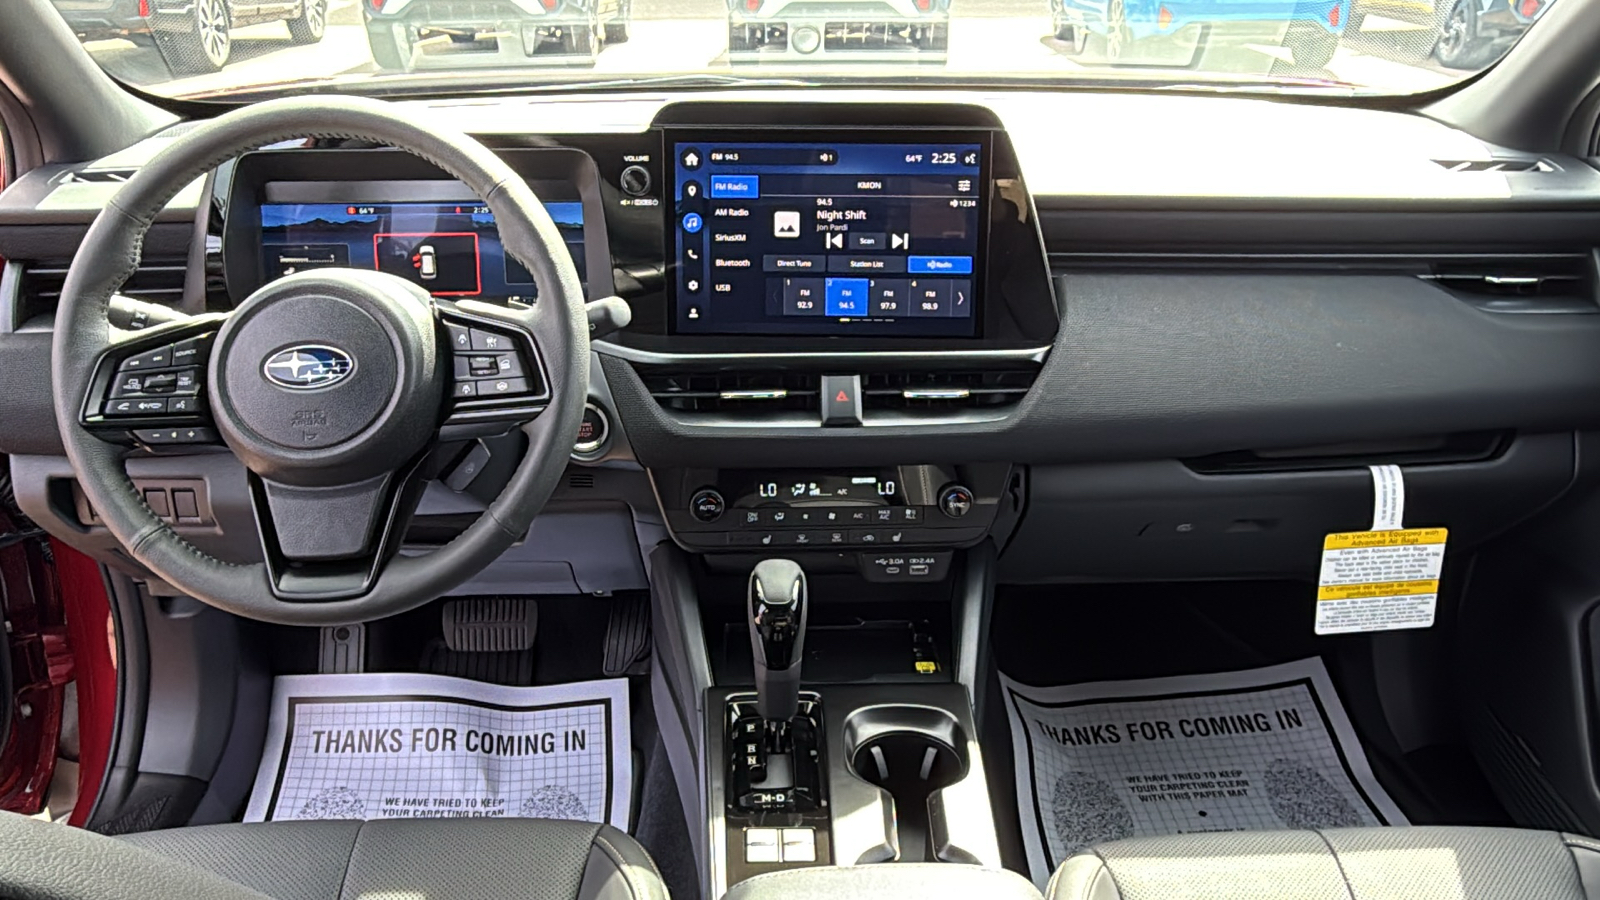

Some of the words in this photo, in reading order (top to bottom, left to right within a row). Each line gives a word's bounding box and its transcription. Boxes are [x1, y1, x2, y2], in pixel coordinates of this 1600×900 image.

[711, 153, 723, 161] FM
[931, 152, 957, 164] 2:25
[715, 183, 726, 191] FM
[727, 182, 748, 191] Radio
[857, 181, 882, 189] KMON
[816, 198, 833, 206] 94.5
[715, 208, 727, 216] AM
[729, 208, 749, 216] Radio
[816, 209, 843, 222] Night
[845, 209, 867, 220] Shift
[816, 223, 829, 232] Jon
[830, 223, 848, 231] Pardi
[715, 233, 747, 242] SiriusXM
[860, 237, 875, 245] Scan
[715, 258, 750, 267] Bluetooth
[777, 259, 796, 267] Direct
[796, 259, 812, 267] Tune
[850, 260, 872, 268] Station
[873, 260, 884, 268] List
[715, 283, 731, 292] USB
[883, 290, 894, 298] FM
[797, 301, 813, 309] 92.9
[838, 302, 855, 310] 94.5
[880, 302, 897, 310] 97.9
[922, 303, 938, 311] 98.9
[760, 483, 778, 498] LO
[837, 488, 848, 496] A/C
[878, 481, 895, 496] LO
[699, 504, 716, 512] AUTO
[949, 501, 966, 509] SYNC
[853, 512, 864, 520] A/C
[1389, 529, 1422, 538] Equipped
[1351, 538, 1386, 547] Advanced
[1400, 536, 1419, 545] Bags
[888, 557, 904, 565] 3.0A
[919, 557, 935, 565] 2.4A
[1033, 719, 1121, 746] THANKS
[1126, 721, 1175, 742] FOR
[1178, 712, 1272, 738] COMING
[1275, 708, 1303, 731] IN
[312, 727, 403, 754] THANKS
[411, 727, 457, 753] FOR
[465, 729, 556, 757] COMING
[564, 728, 586, 753] IN
[746, 755, 758, 765] N
[1126, 776, 1143, 784] WE
[1143, 774, 1170, 784] HAVE
[1171, 772, 1201, 782] TRIED
[1203, 770, 1216, 780] TO
[1218, 769, 1242, 779] KEEP
[1129, 784, 1158, 794] YOUR
[1159, 781, 1216, 792] CARPETING
[1216, 779, 1249, 789] CLEAN
[1138, 793, 1166, 803] WITH
[1168, 791, 1191, 801] THIS
[1192, 789, 1226, 800] PAPER
[1226, 788, 1248, 797] MAT
[385, 797, 401, 807] WE
[402, 797, 430, 808] HAVE
[432, 797, 462, 808] TRIED
[464, 797, 478, 808] TO
[480, 797, 505, 808] KEEP
[382, 808, 410, 817] YOUR
[412, 809, 470, 819] CARPETING
[472, 808, 505, 819] CLEAN
